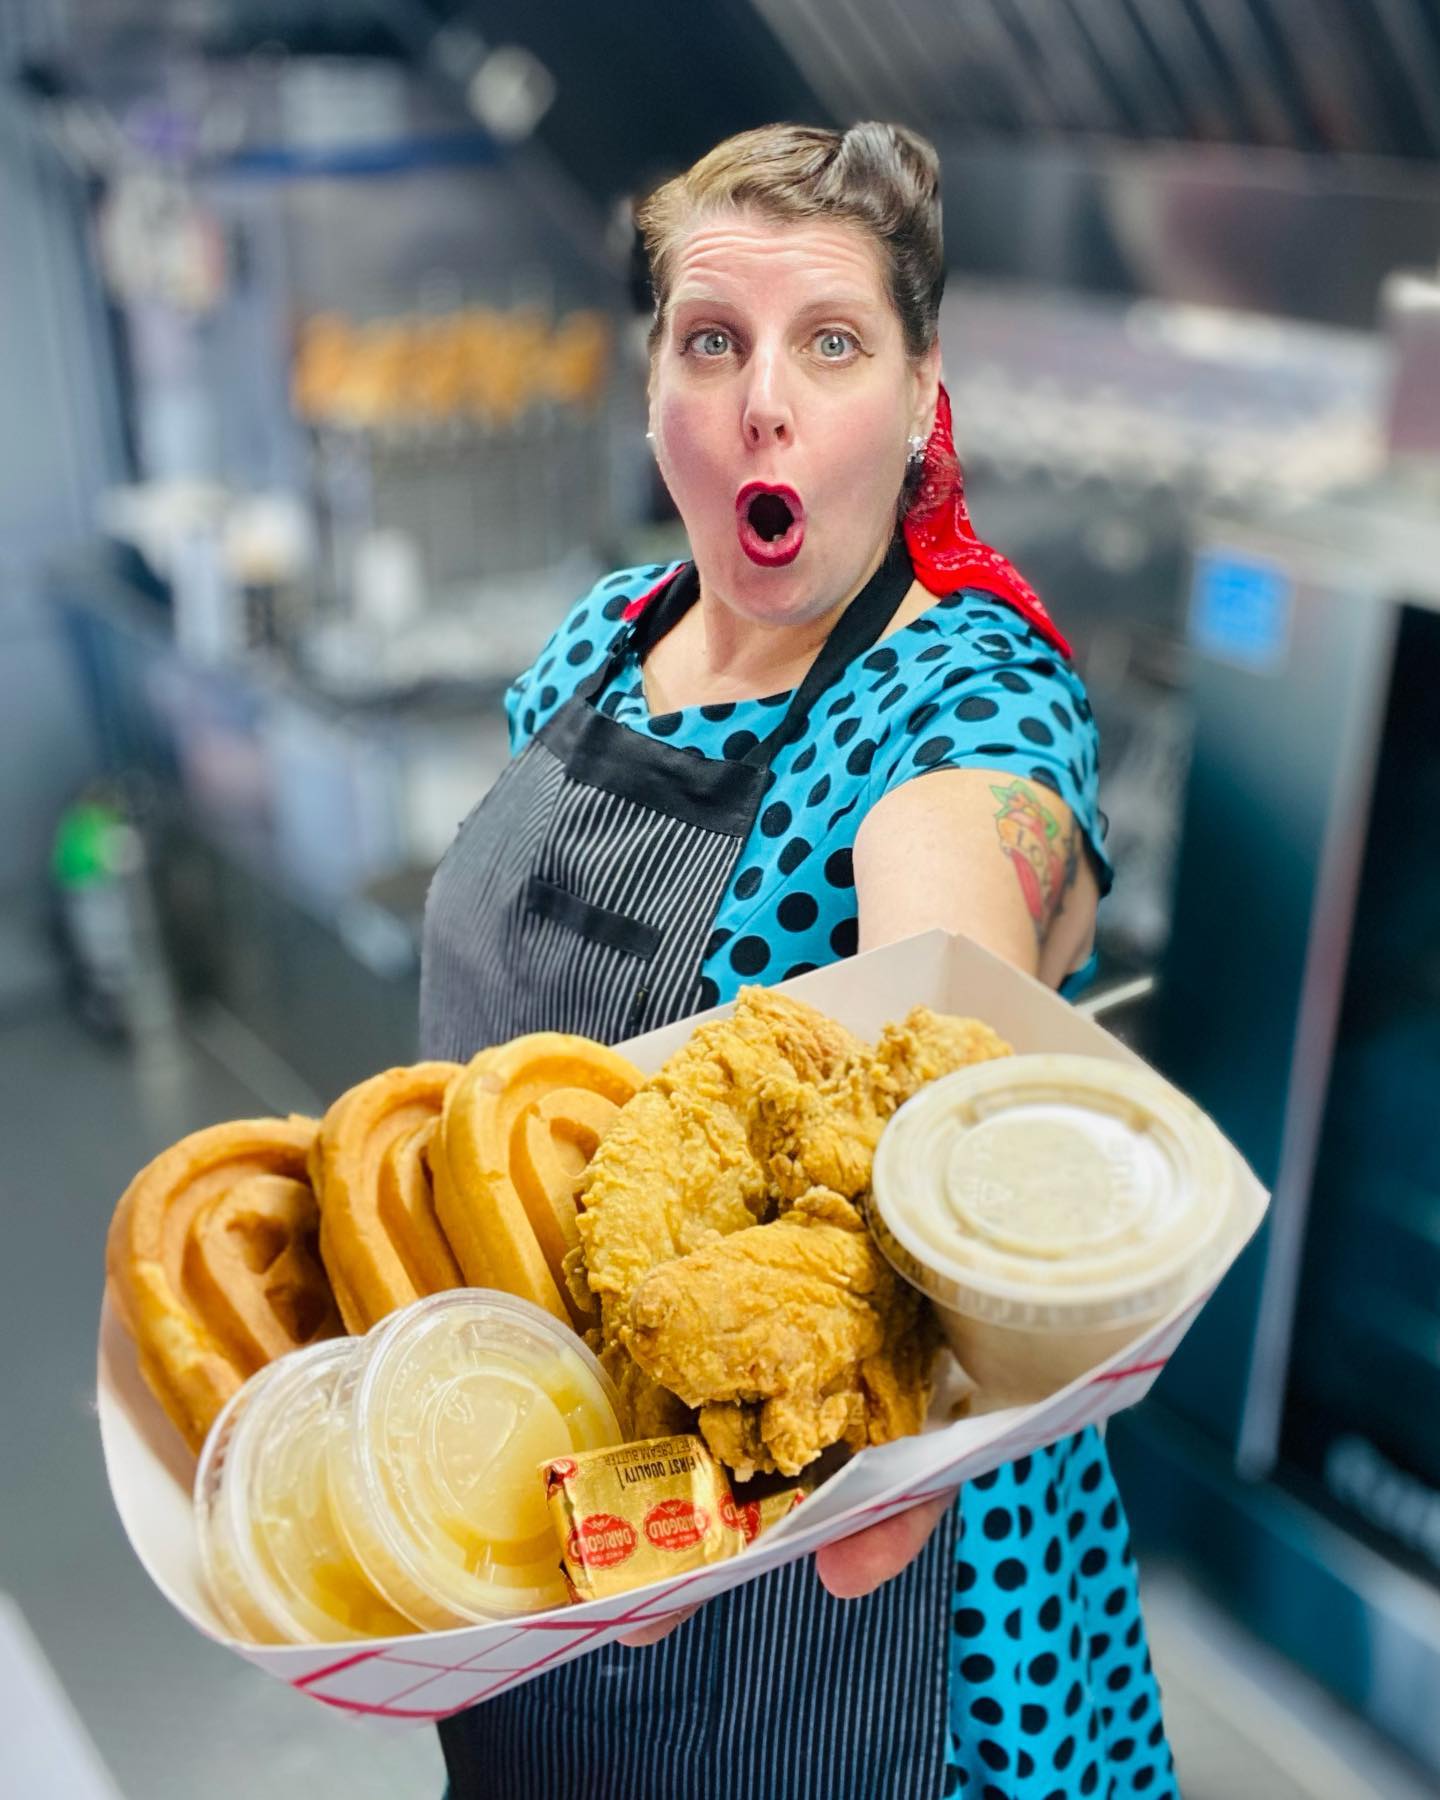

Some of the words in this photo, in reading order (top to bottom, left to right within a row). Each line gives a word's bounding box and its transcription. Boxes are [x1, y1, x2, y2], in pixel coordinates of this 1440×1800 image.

[604, 1450, 639, 1466] BUTTER
[640, 1441, 674, 1460] CREAM
[624, 1461, 666, 1483] QUALITY
[668, 1455, 697, 1476] FIRST
